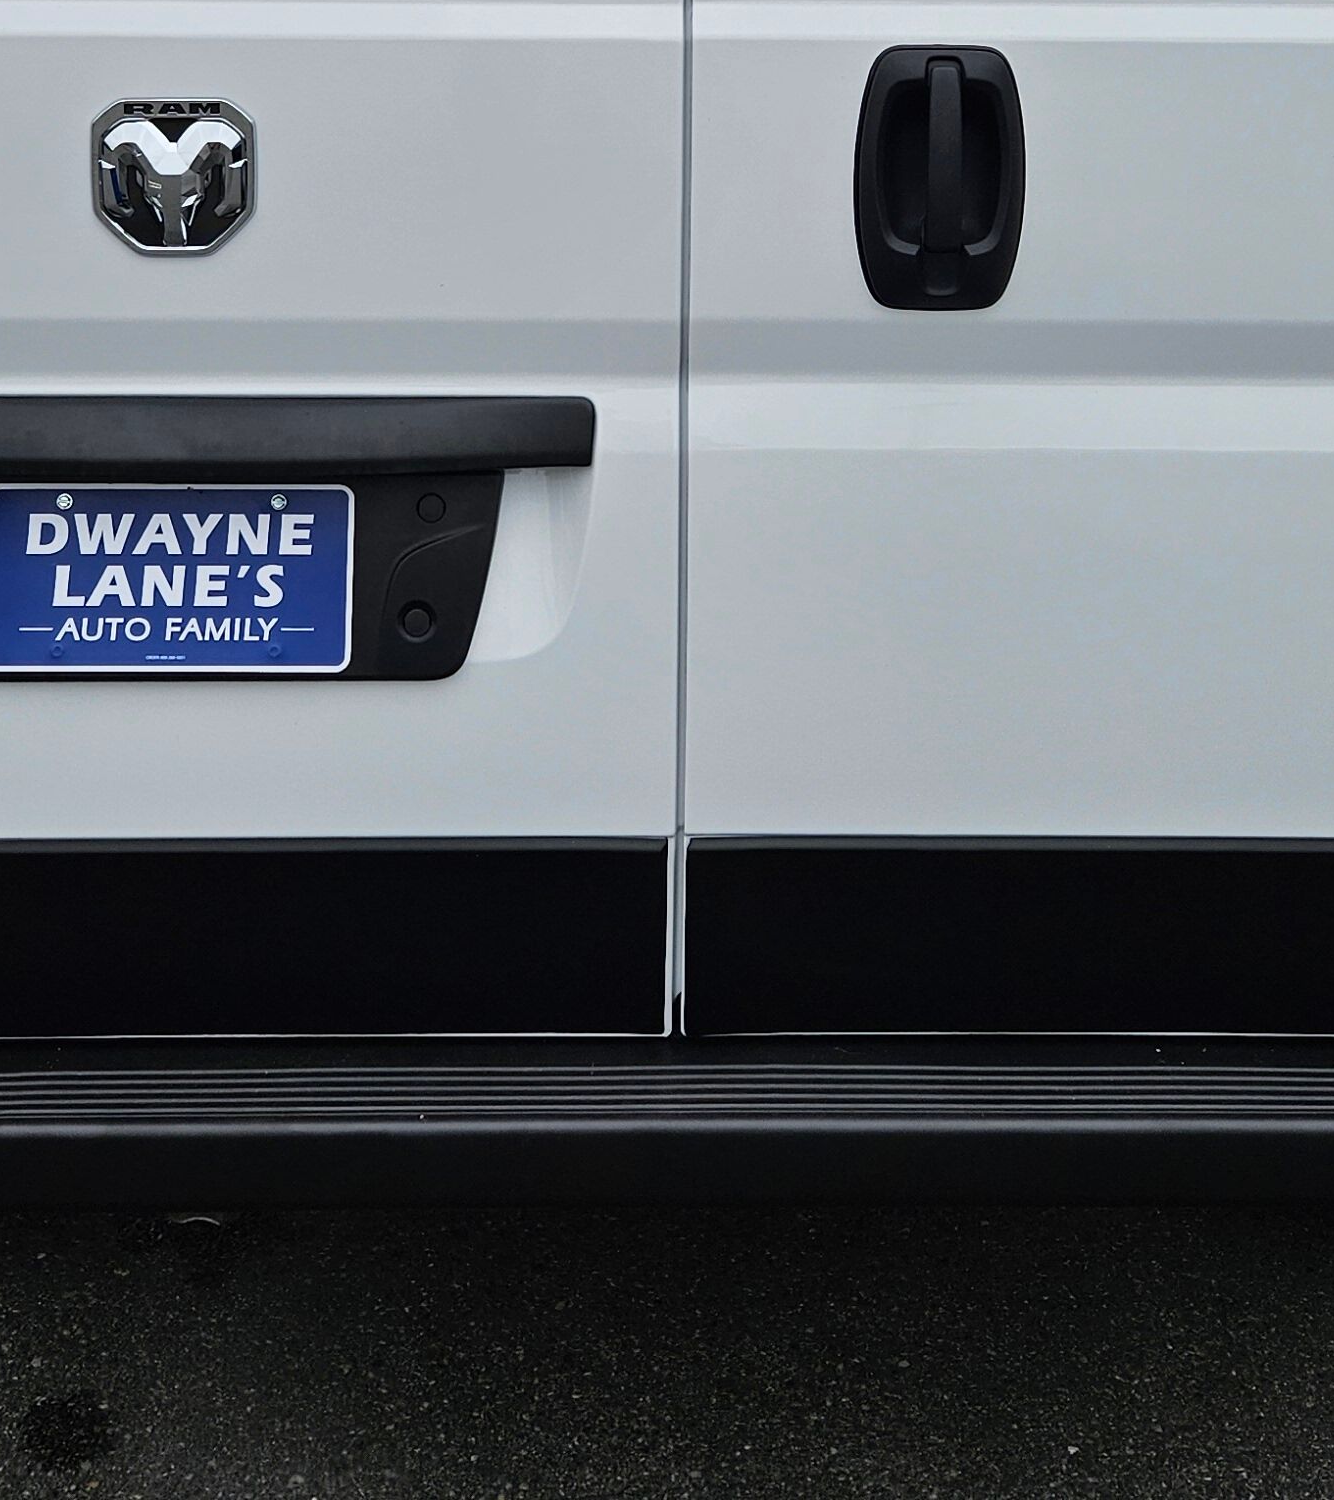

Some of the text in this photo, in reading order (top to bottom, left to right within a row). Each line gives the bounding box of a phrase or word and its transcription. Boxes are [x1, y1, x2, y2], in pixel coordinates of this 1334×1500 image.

[123, 101, 221, 116] RAM
[25, 512, 315, 556] DWAYNE
[51, 564, 285, 608] LANE'S
[55, 617, 279, 642] AUTO FAMILY
